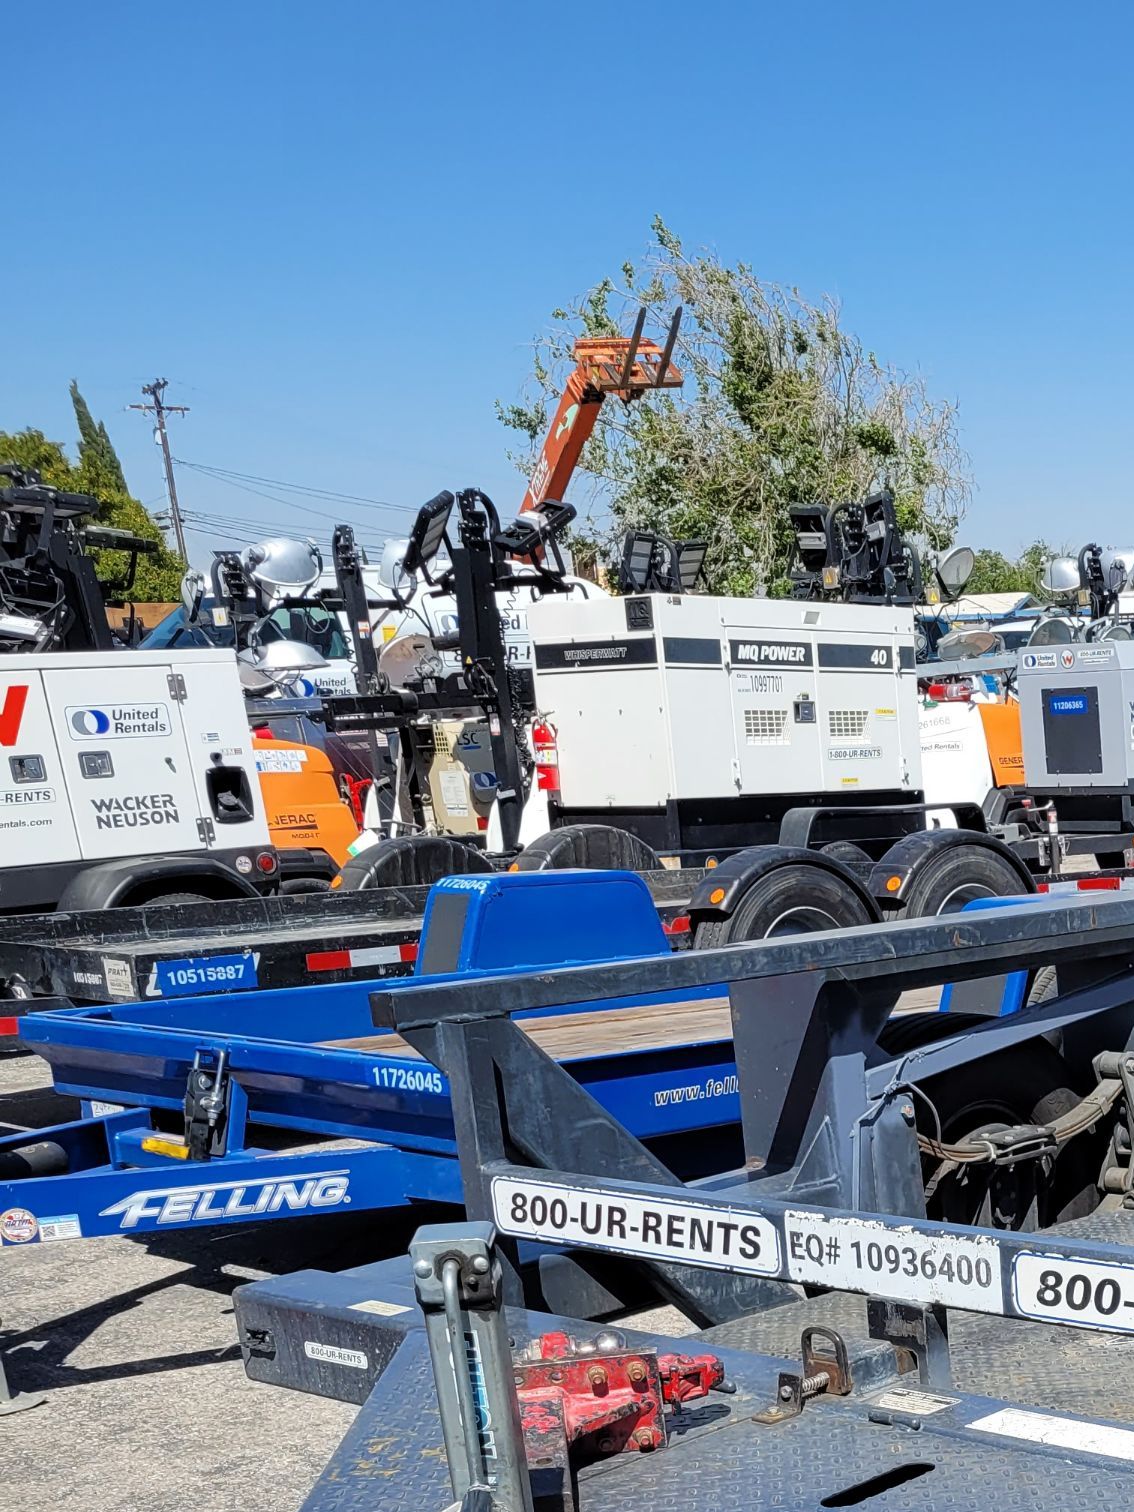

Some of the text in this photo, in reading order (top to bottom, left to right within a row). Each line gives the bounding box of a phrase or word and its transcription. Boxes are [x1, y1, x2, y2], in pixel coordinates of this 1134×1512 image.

[563, 647, 628, 661] WHISPERWATT
[738, 644, 806, 662] MQ POWER
[870, 649, 887, 665] 40
[314, 677, 347, 688] United
[750, 675, 783, 692] 10997701
[1053, 700, 1083, 710] 11206365
[112, 708, 159, 721] United
[114, 721, 167, 734] Rentals
[829, 749, 881, 759] 1-800-UR-RENTS
[934, 742, 961, 751] Rentals
[999, 757, 1024, 765] GENER
[90, 794, 177, 813] WACKER
[96, 809, 180, 830] NEUSON
[166, 964, 245, 986] 10515887
[371, 1066, 443, 1095] 11726045
[99, 1169, 351, 1229] FELLING
[509, 1190, 762, 1261] 800-UR-RENTS
[788, 1228, 842, 1267] EQ#
[849, 1238, 993, 1290] 10936400
[310, 1345, 363, 1366] 800-UR-RENTS
